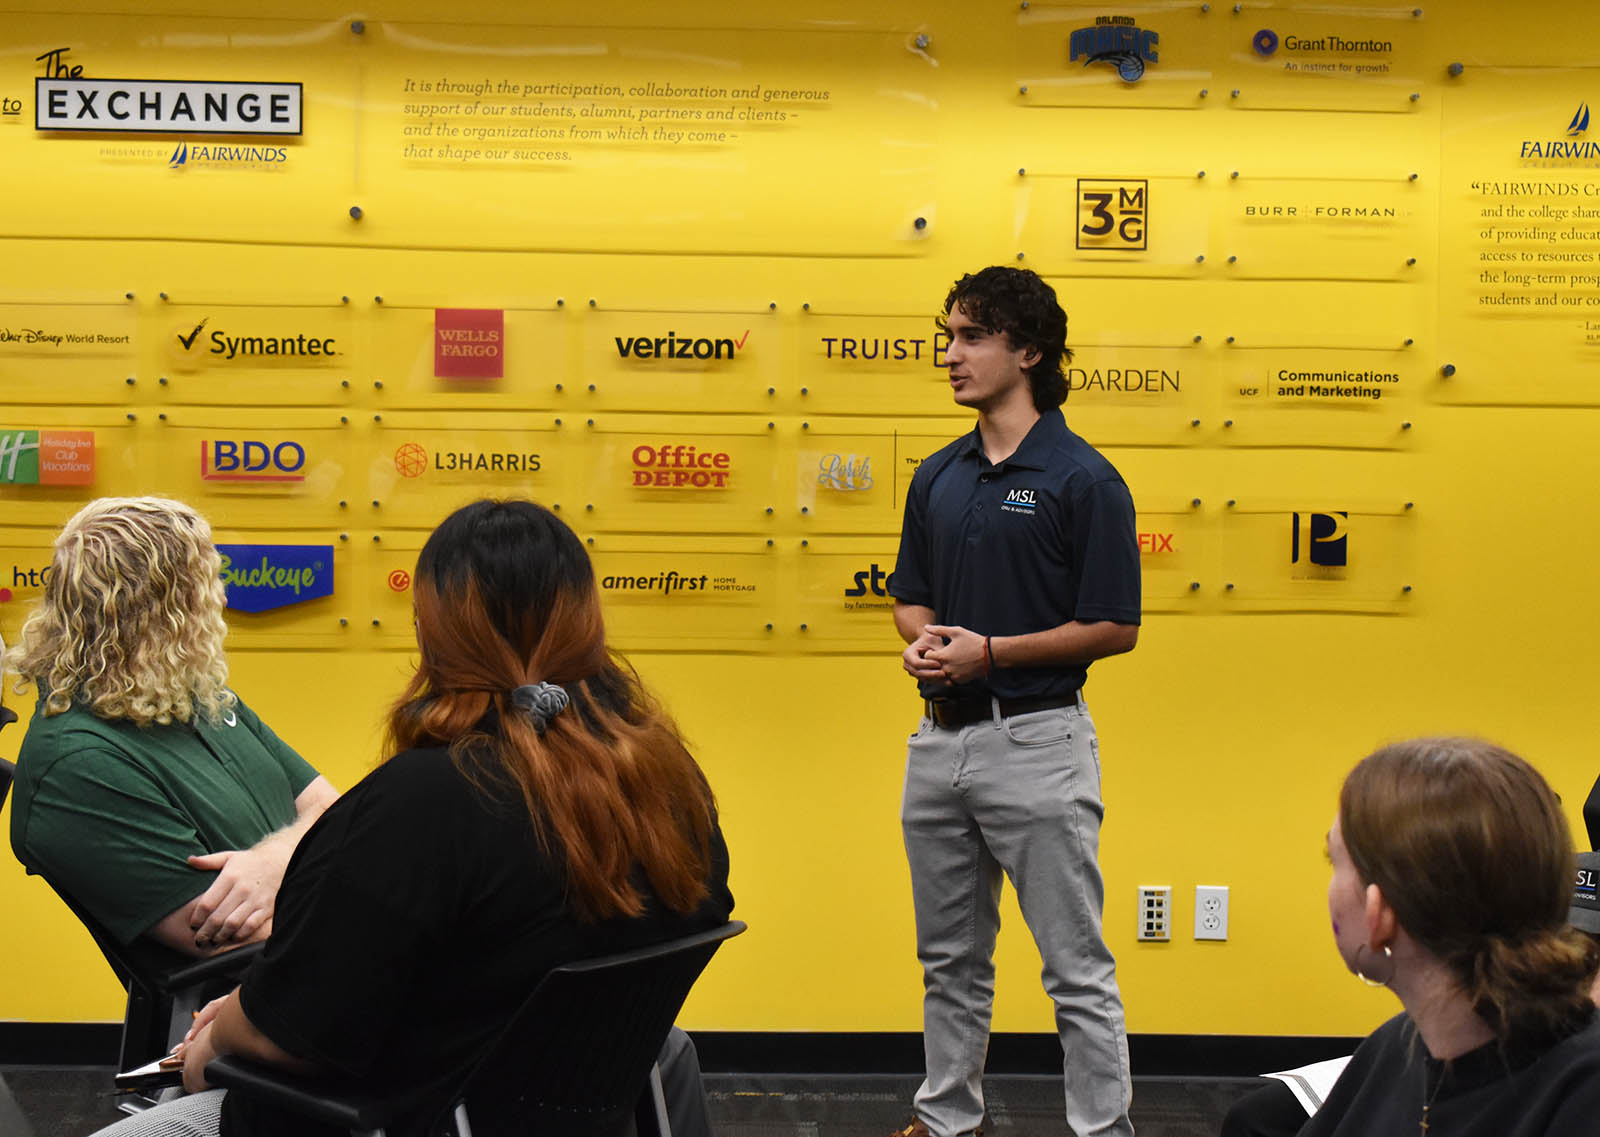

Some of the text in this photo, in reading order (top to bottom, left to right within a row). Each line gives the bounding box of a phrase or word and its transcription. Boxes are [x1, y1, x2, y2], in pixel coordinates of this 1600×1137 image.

[1096, 16, 1136, 26] ORLANDO
[1285, 35, 1393, 53] Grant Thornton
[36, 47, 84, 80] The
[1285, 62, 1390, 74] An instinct for growth
[404, 79, 831, 103] It is through the participation, collaboration and generous
[2, 97, 22, 112] to
[48, 89, 291, 123] EXCHANGE
[404, 103, 461, 118] support
[464, 101, 481, 116] of
[482, 105, 505, 116] our
[510, 103, 577, 119] students,
[580, 104, 636, 120] alumni,
[638, 107, 703, 122] partners
[706, 106, 735, 121] and
[738, 107, 787, 122] clients
[403, 123, 433, 137] and
[436, 123, 459, 138] the
[463, 125, 566, 141] organizations
[569, 125, 602, 140] from
[607, 126, 649, 141] which
[653, 127, 684, 144] they
[688, 131, 727, 142] come
[190, 146, 288, 162] FAIRWINDS
[404, 144, 573, 162] that shape our success.
[1082, 193, 1115, 236] 3
[1246, 206, 1297, 216] BURR
[1315, 207, 1395, 217] FORMAN
[1481, 204, 1503, 217] and
[1506, 205, 1525, 217] the
[1528, 205, 1569, 221] college
[1480, 226, 1496, 239] of
[1497, 227, 1557, 243] providing
[1480, 252, 1594, 262] access to resources
[1480, 270, 1500, 283] the
[1503, 271, 1566, 287] long-term
[1479, 292, 1531, 305] students
[1534, 293, 1558, 305] and
[1561, 297, 1583, 305] our
[66, 334, 94, 344] World
[97, 334, 129, 344] Resort
[439, 329, 499, 342] WELLS
[210, 331, 336, 359] Symantec
[440, 344, 498, 357] FARGO
[615, 331, 735, 360] verizon
[822, 338, 926, 360] TRUIST
[1069, 368, 1180, 392] DARDEN
[1278, 370, 1399, 383] Communications
[1239, 388, 1259, 396] UCF
[1278, 385, 1381, 399] and Marketing
[56, 449, 78, 460] Club
[214, 440, 305, 472] BDO
[435, 452, 541, 472] L3HARRIS
[632, 445, 730, 469] Office
[42, 460, 91, 471] Vacations
[632, 471, 729, 487] DEPOT
[1006, 489, 1036, 504] MSL
[1138, 533, 1174, 553] FIX
[220, 554, 315, 595] Buckeye
[602, 571, 708, 595] amerifirst
[1575, 870, 1596, 887] SL
